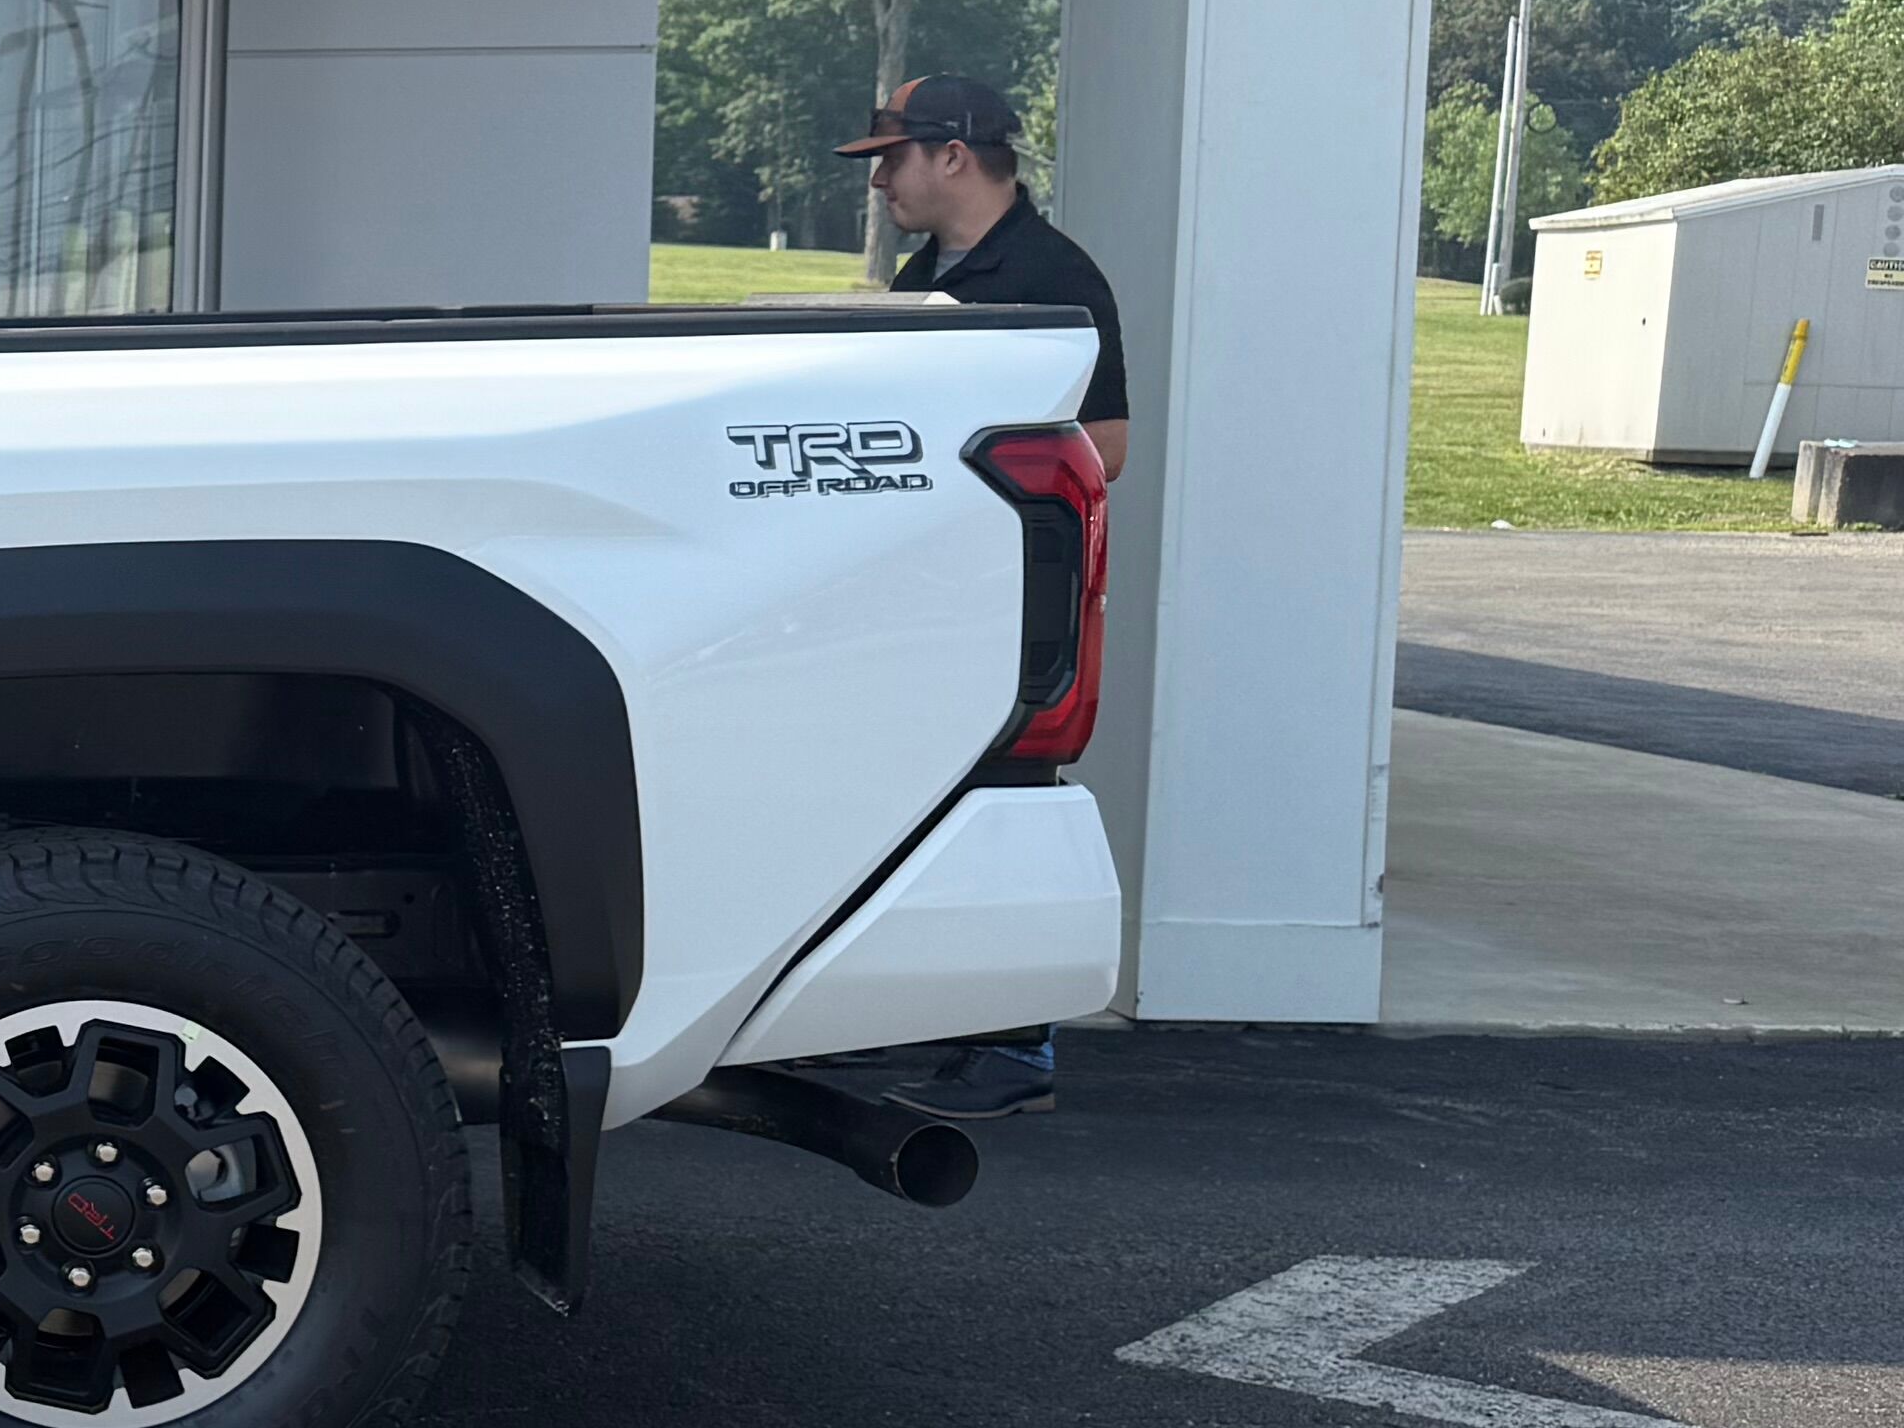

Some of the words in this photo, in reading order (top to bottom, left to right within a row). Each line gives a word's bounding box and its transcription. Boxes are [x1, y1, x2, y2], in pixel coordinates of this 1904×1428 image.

[726, 421, 923, 479] TRD
[729, 478, 811, 499] OFF
[817, 474, 933, 495] ROAD
[67, 1192, 115, 1241] TRD
